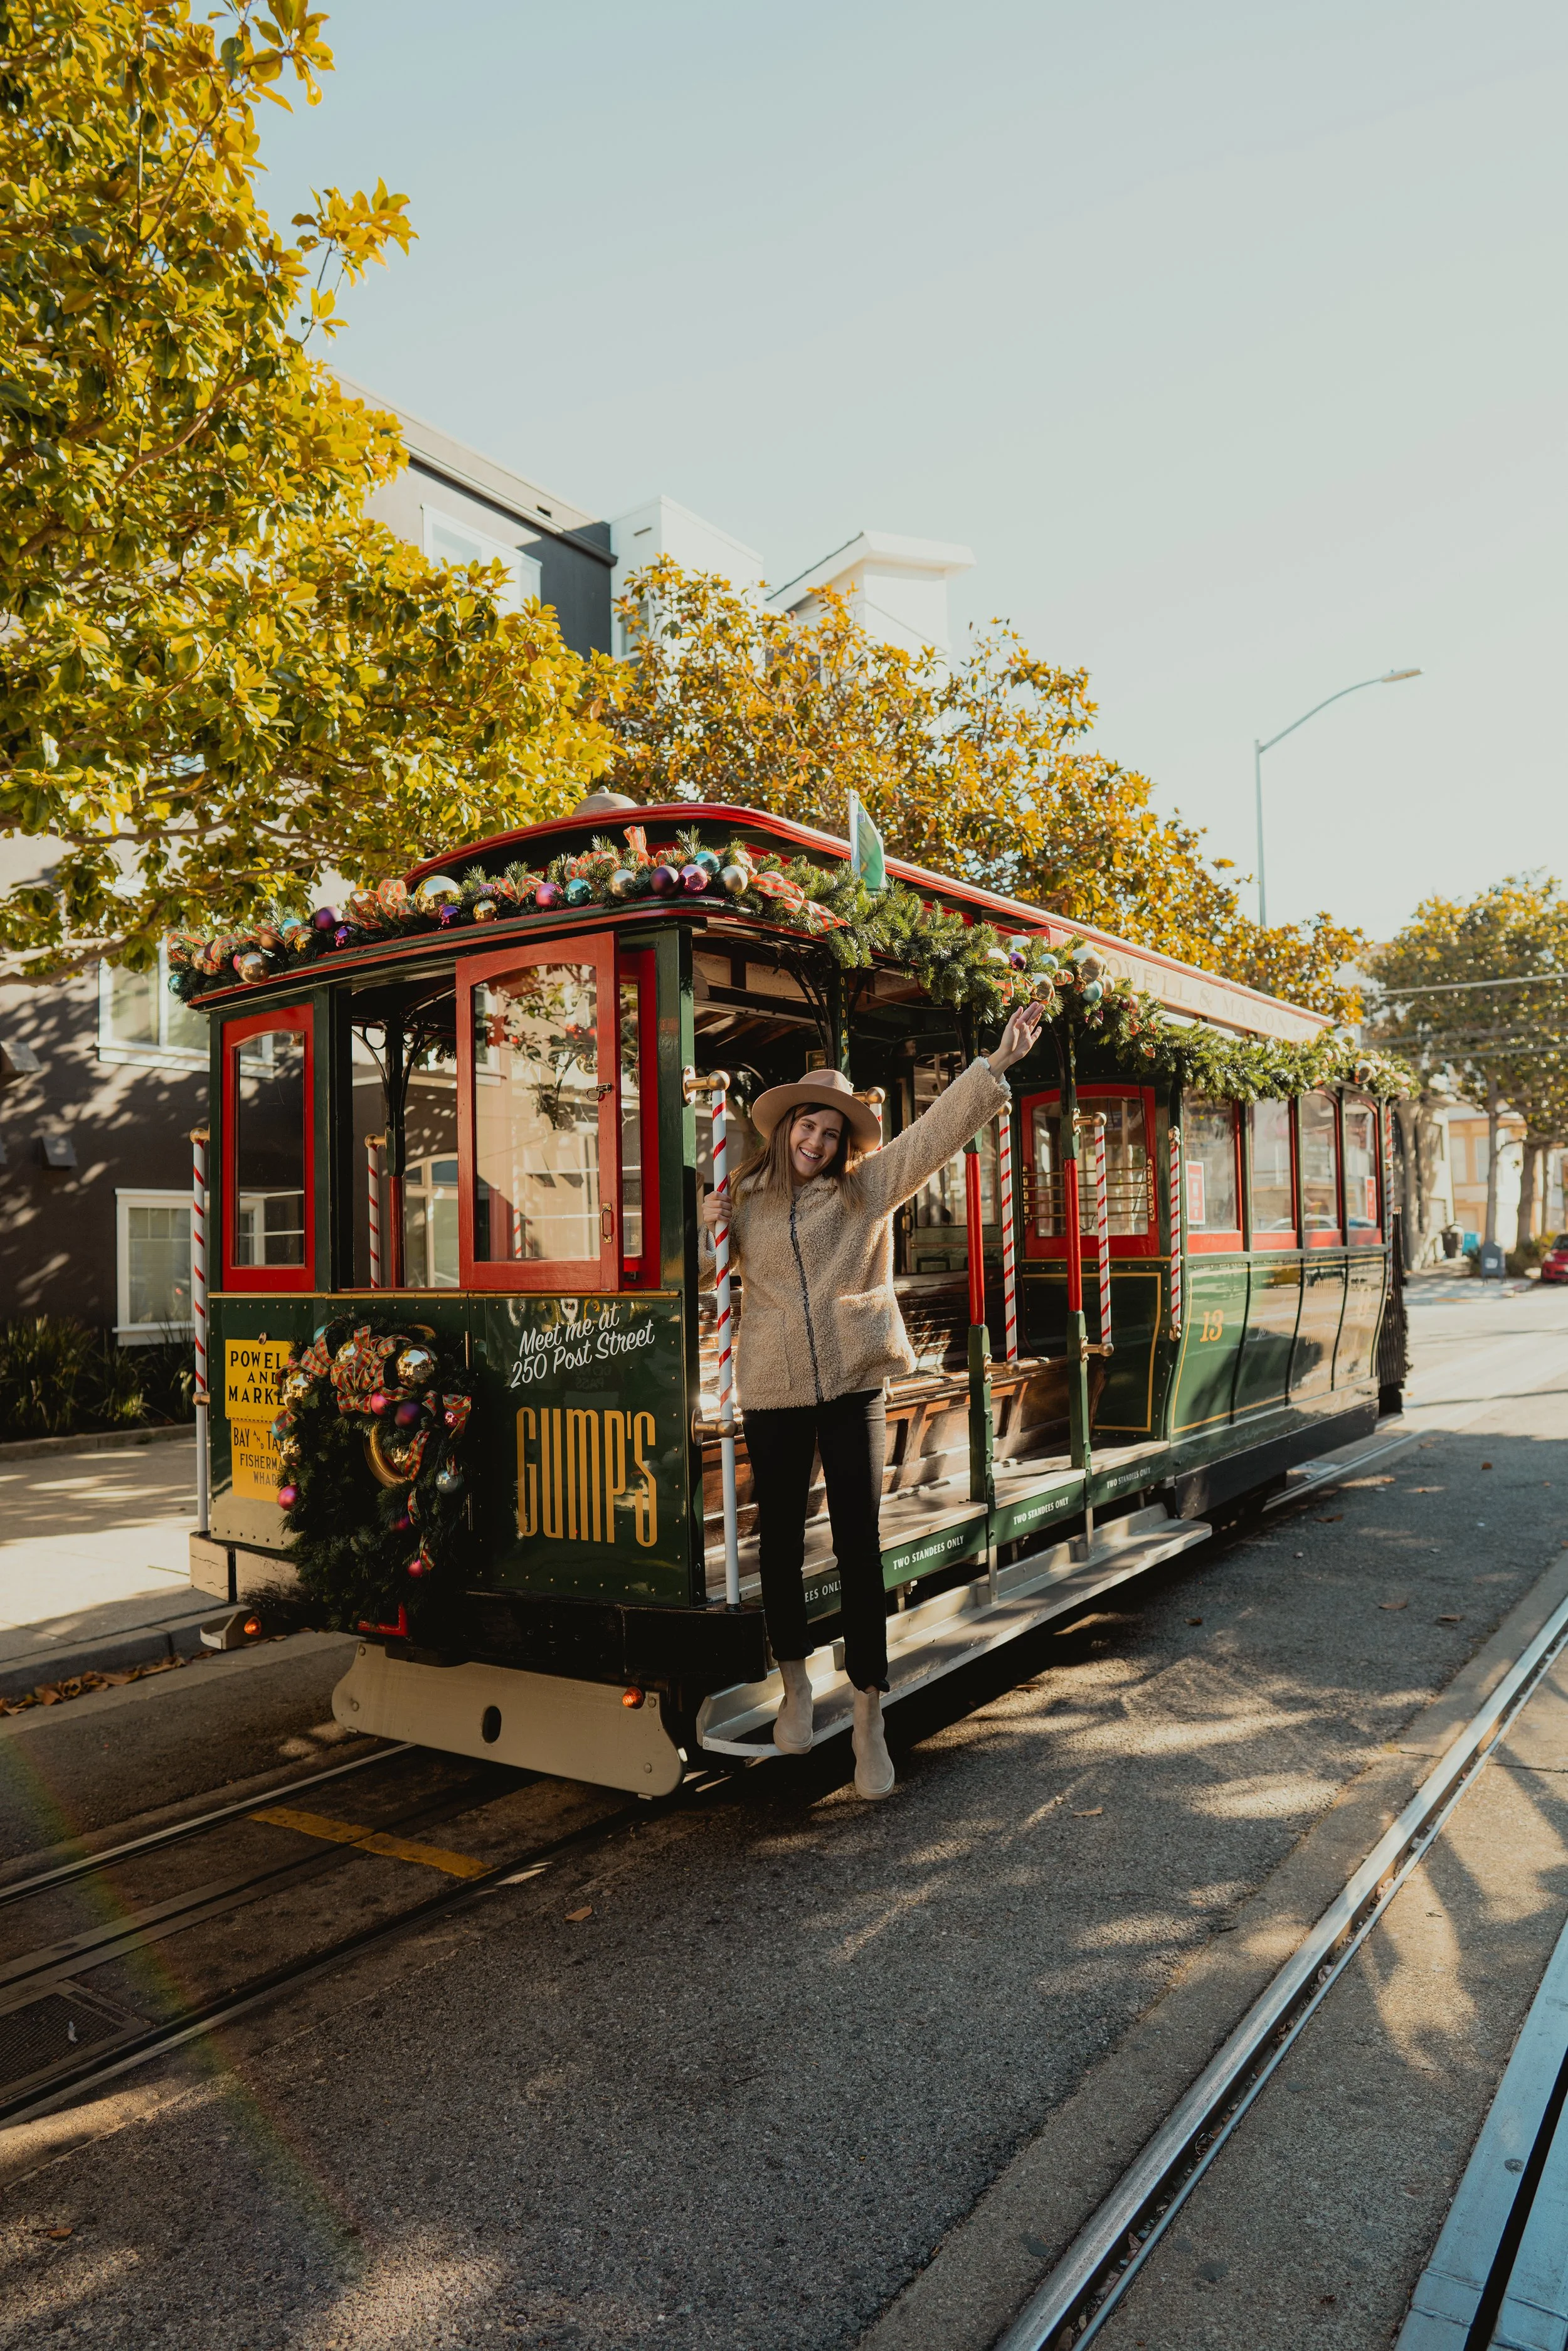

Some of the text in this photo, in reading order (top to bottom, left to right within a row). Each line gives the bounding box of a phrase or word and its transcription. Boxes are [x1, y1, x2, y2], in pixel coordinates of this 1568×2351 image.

[1199, 987, 1212, 1011] &
[1222, 995, 1288, 1036] MASON
[519, 1302, 620, 1357] Meet me at
[1199, 1308, 1224, 1342] 13
[510, 1319, 655, 1389] 250 Post Street
[234, 1427, 282, 1451] BAY AND TA
[516, 1406, 658, 1547] GUMP'S
[1106, 1467, 1151, 1489] TWO STANDEES ONLY
[1014, 1496, 1069, 1526] TWO STANDEES ONLY
[893, 1535, 964, 1570] TWO STANDEES ONLY
